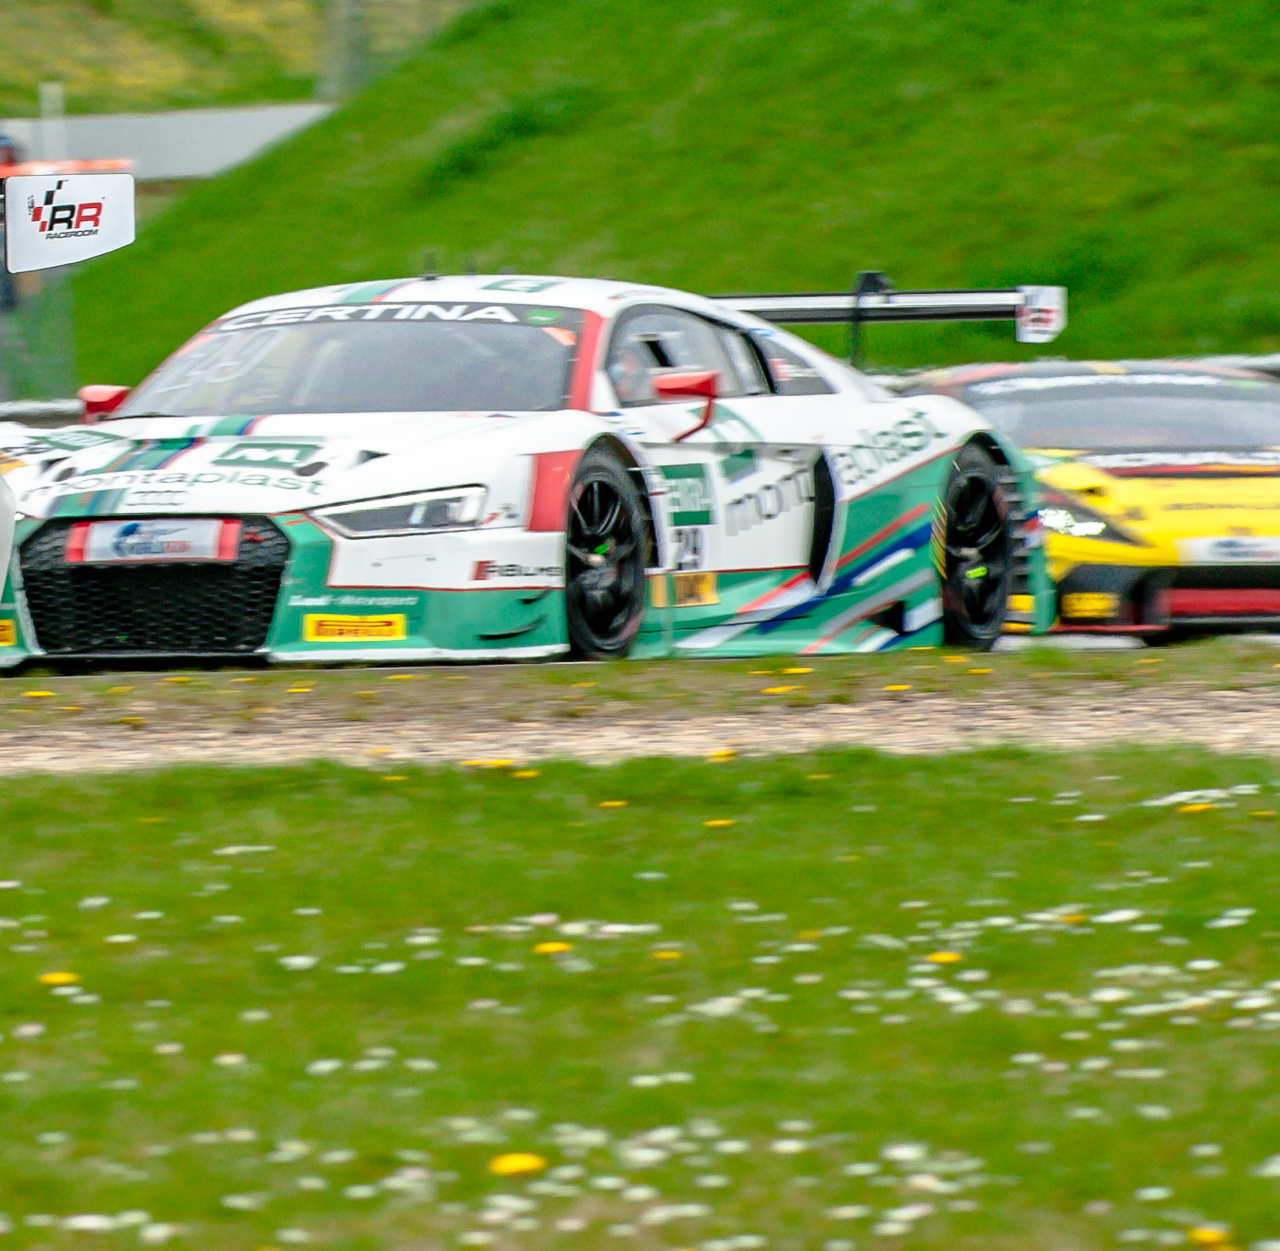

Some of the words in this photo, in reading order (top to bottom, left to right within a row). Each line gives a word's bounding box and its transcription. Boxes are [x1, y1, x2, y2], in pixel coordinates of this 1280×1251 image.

[45, 228, 99, 240] RACEROOM
[219, 303, 522, 333] CERTINA
[21, 469, 330, 501] montaplast
